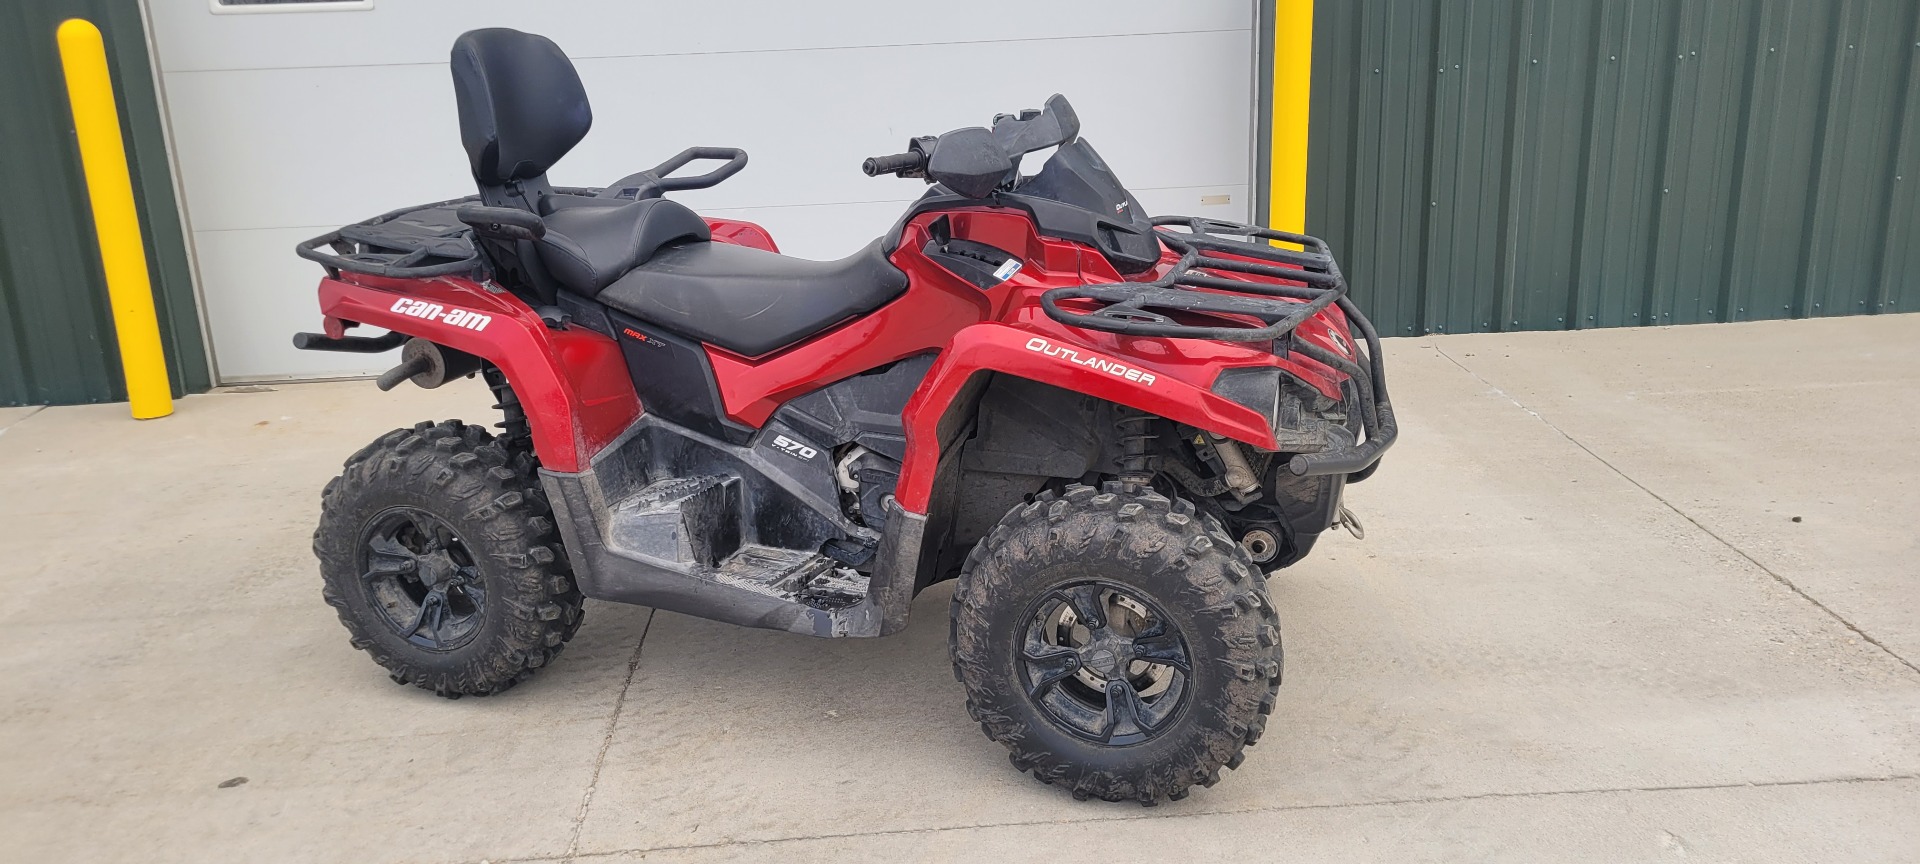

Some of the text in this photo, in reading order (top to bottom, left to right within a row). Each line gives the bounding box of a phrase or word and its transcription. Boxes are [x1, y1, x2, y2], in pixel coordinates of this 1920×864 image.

[390, 297, 491, 332] can-am
[623, 328, 648, 342] MAX
[1025, 337, 1156, 386] OUTLANDER
[773, 434, 818, 459] 570
